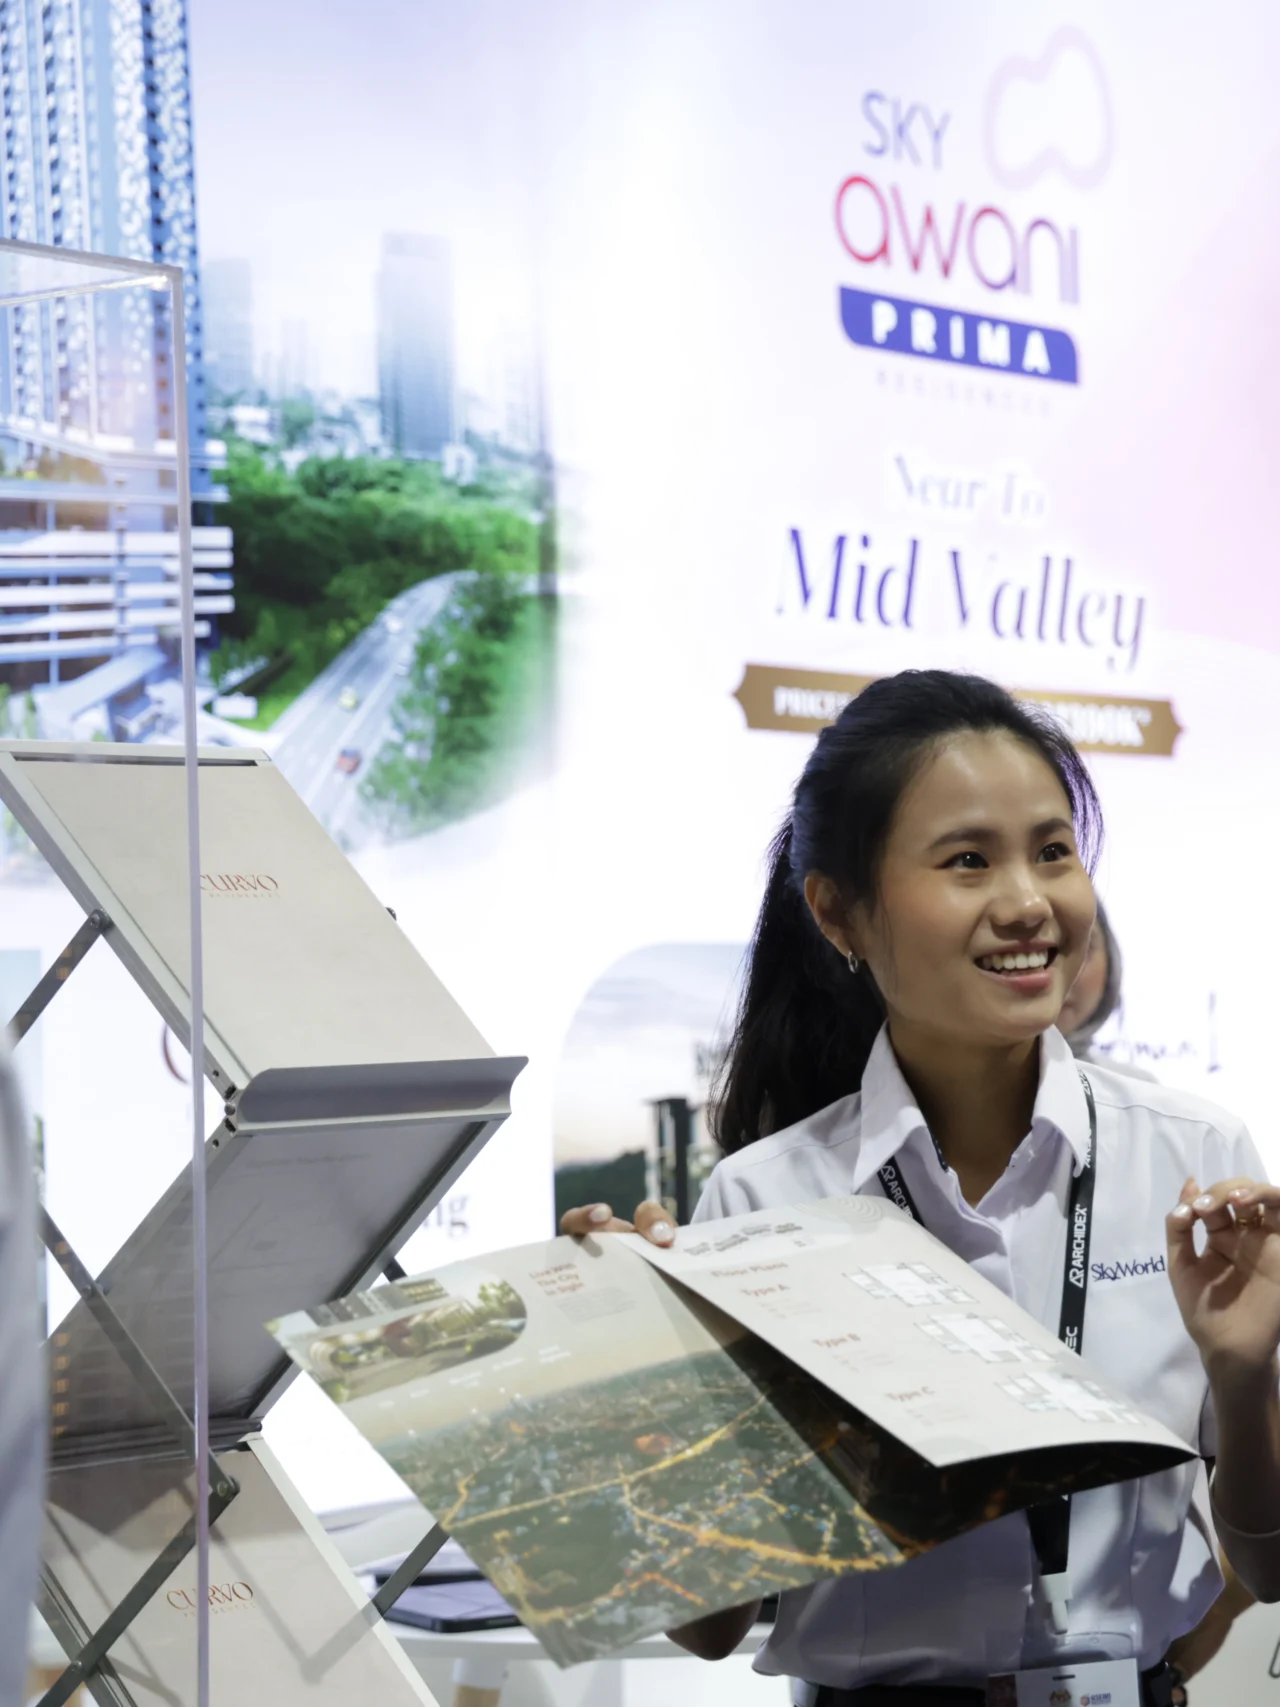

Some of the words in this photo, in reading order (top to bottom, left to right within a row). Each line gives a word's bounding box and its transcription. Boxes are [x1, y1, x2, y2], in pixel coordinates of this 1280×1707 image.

[860, 90, 951, 169] SKY
[871, 300, 1051, 375] PRIMA
[893, 453, 986, 512] Near
[775, 526, 919, 631] Mid
[948, 548, 1145, 674] Valley
[1071, 1205, 1088, 1268] ARCHIDEX
[1090, 1255, 1166, 1281] SkyWorld
